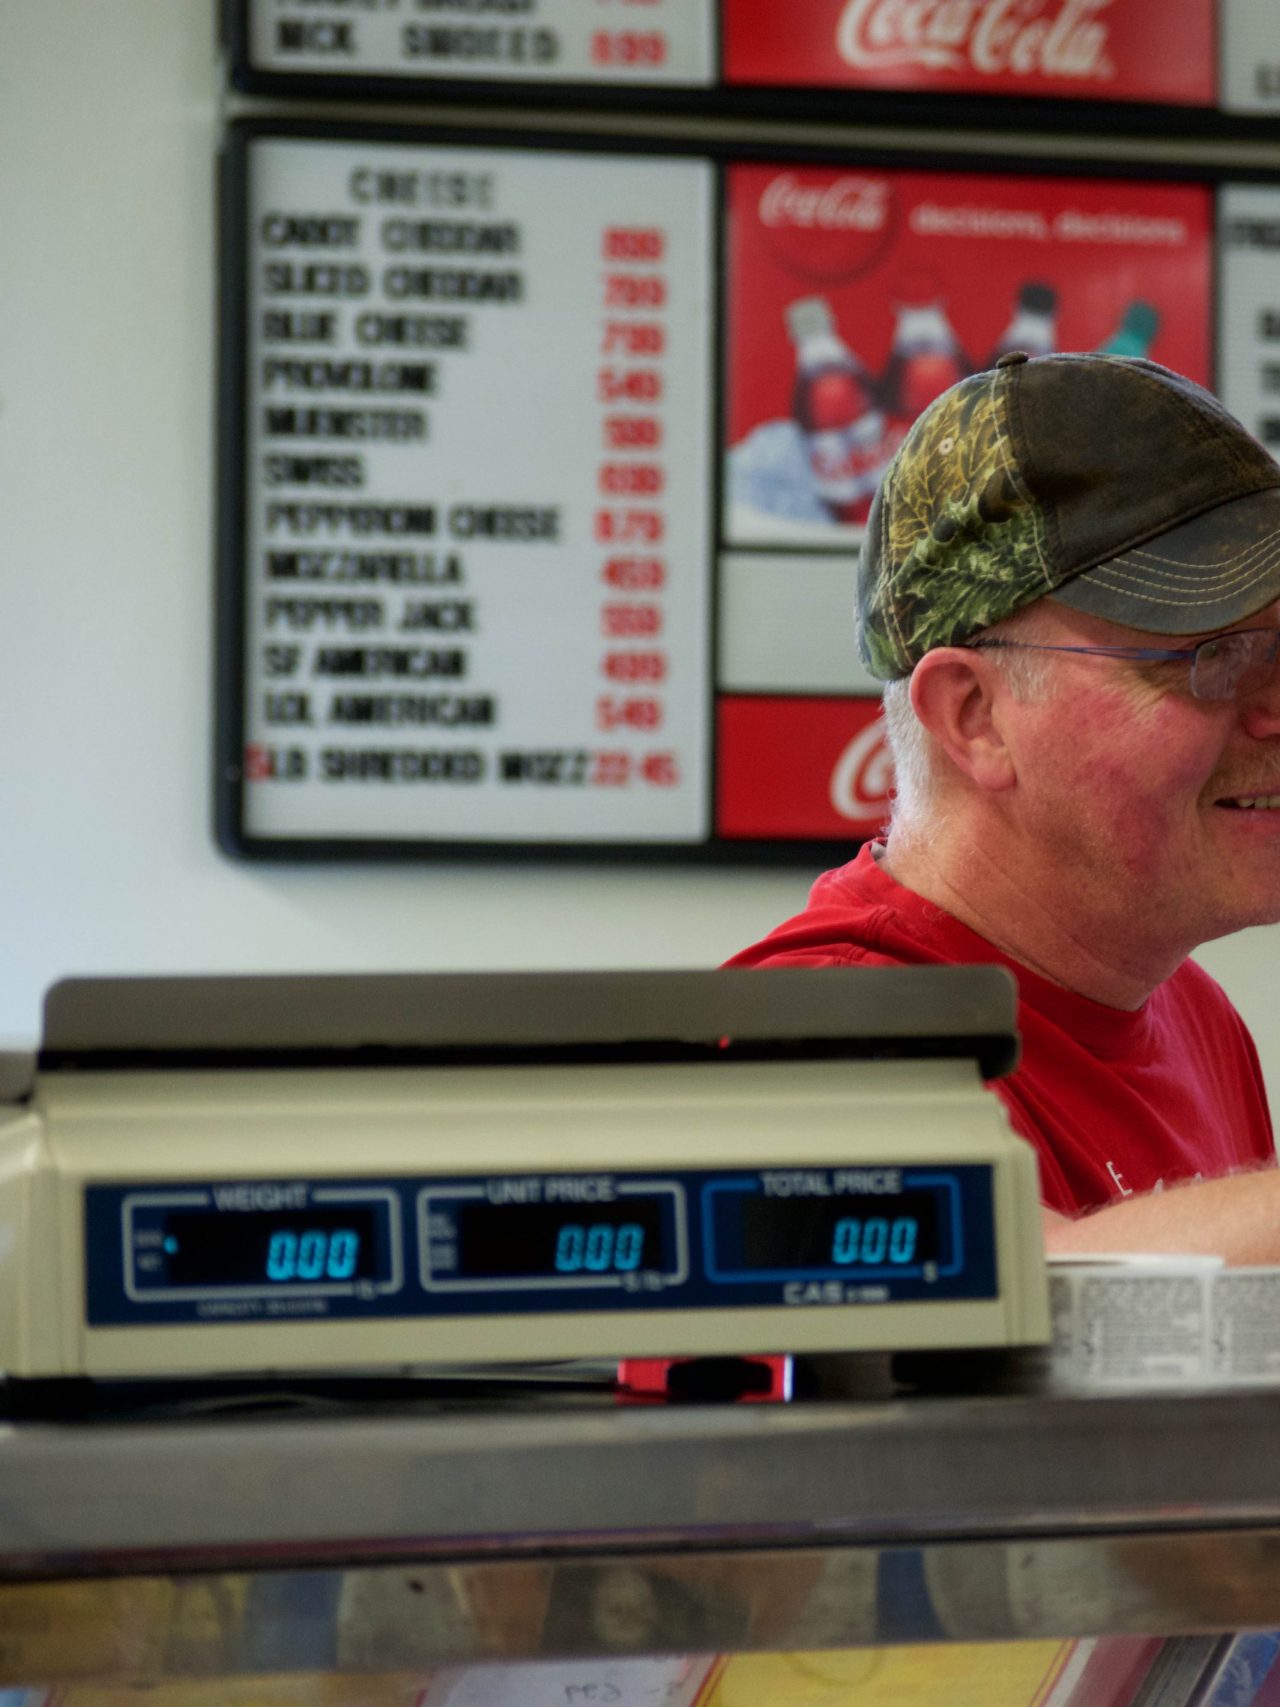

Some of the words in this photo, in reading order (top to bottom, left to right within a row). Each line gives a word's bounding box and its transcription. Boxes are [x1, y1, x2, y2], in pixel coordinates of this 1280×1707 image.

[211, 1182, 309, 1213] WEIGHT
[485, 1179, 542, 1205] UNIT
[544, 1176, 617, 1203] PRICE
[759, 1171, 831, 1199] TOTAL
[833, 1168, 903, 1195] PRICE
